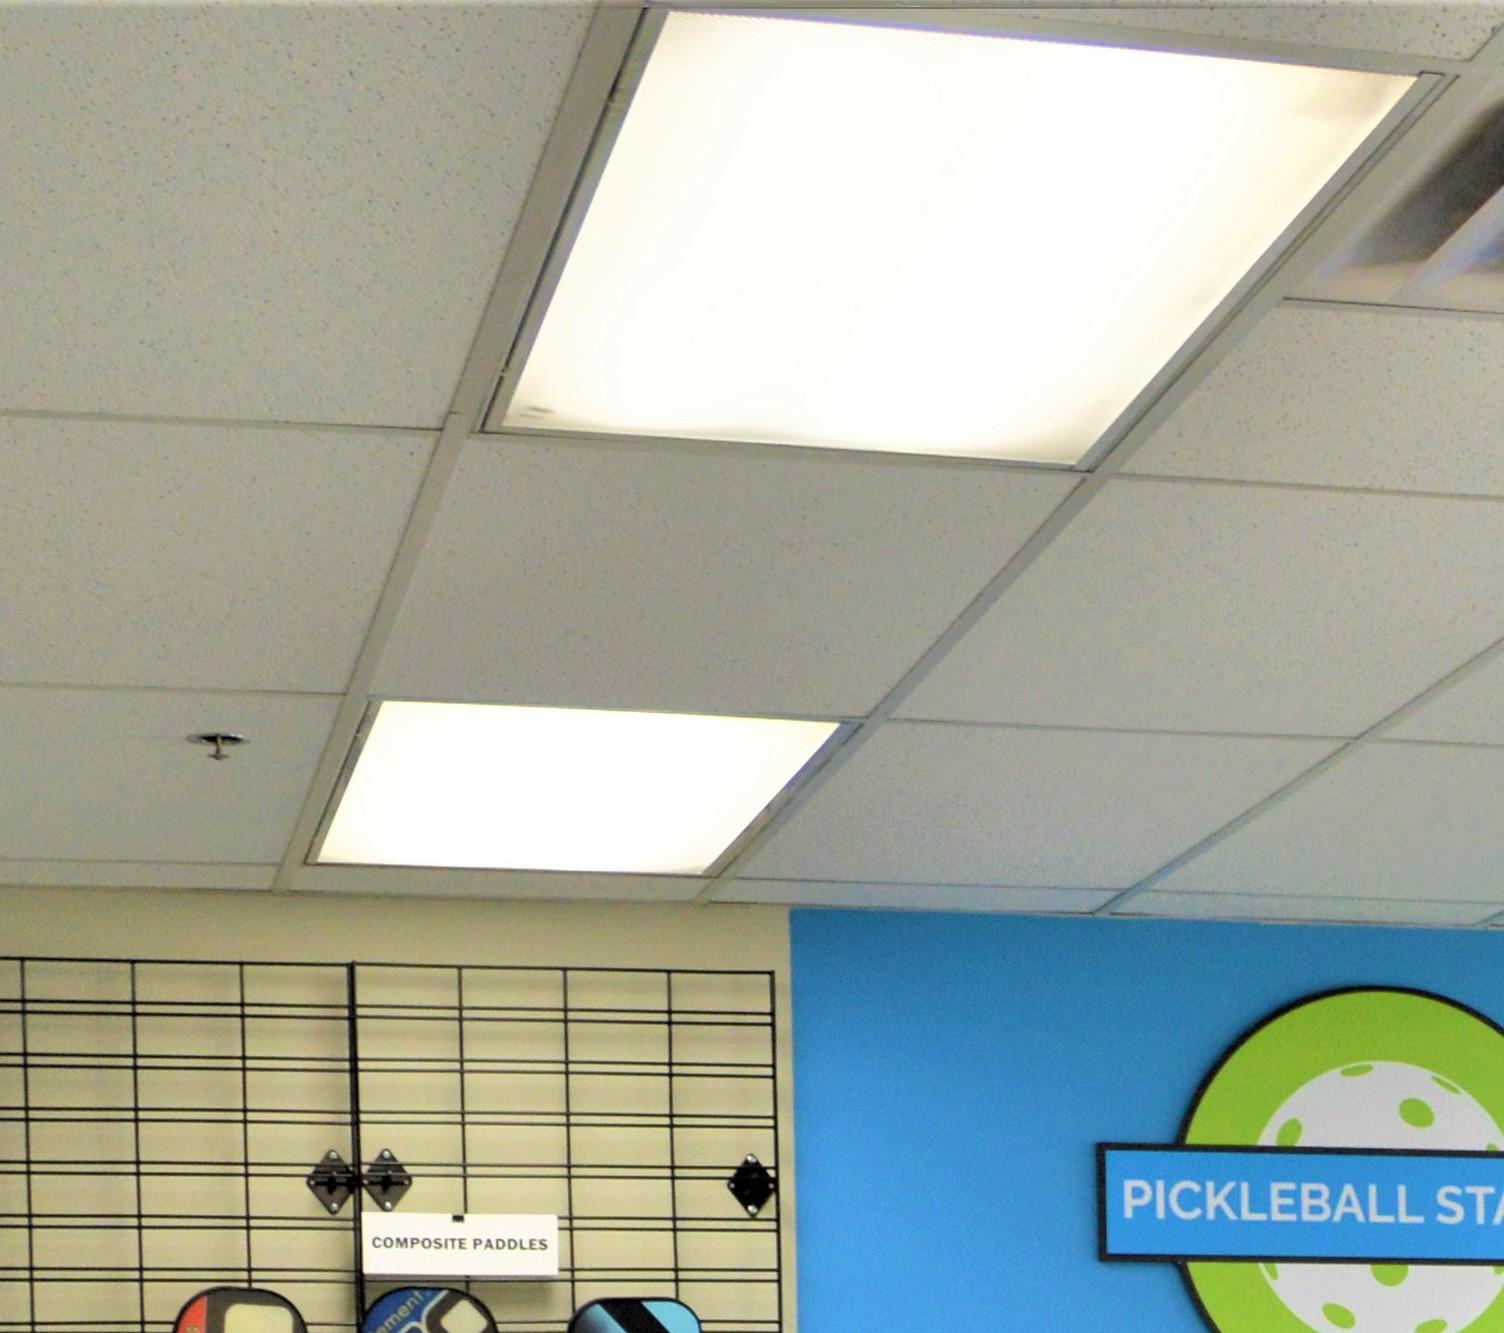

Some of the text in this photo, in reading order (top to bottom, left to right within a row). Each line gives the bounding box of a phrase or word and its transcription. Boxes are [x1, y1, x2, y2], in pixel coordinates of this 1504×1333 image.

[1122, 1178, 1425, 1226] PICKLEBALL
[372, 1237, 548, 1251] COMPOSITE PADDLES
